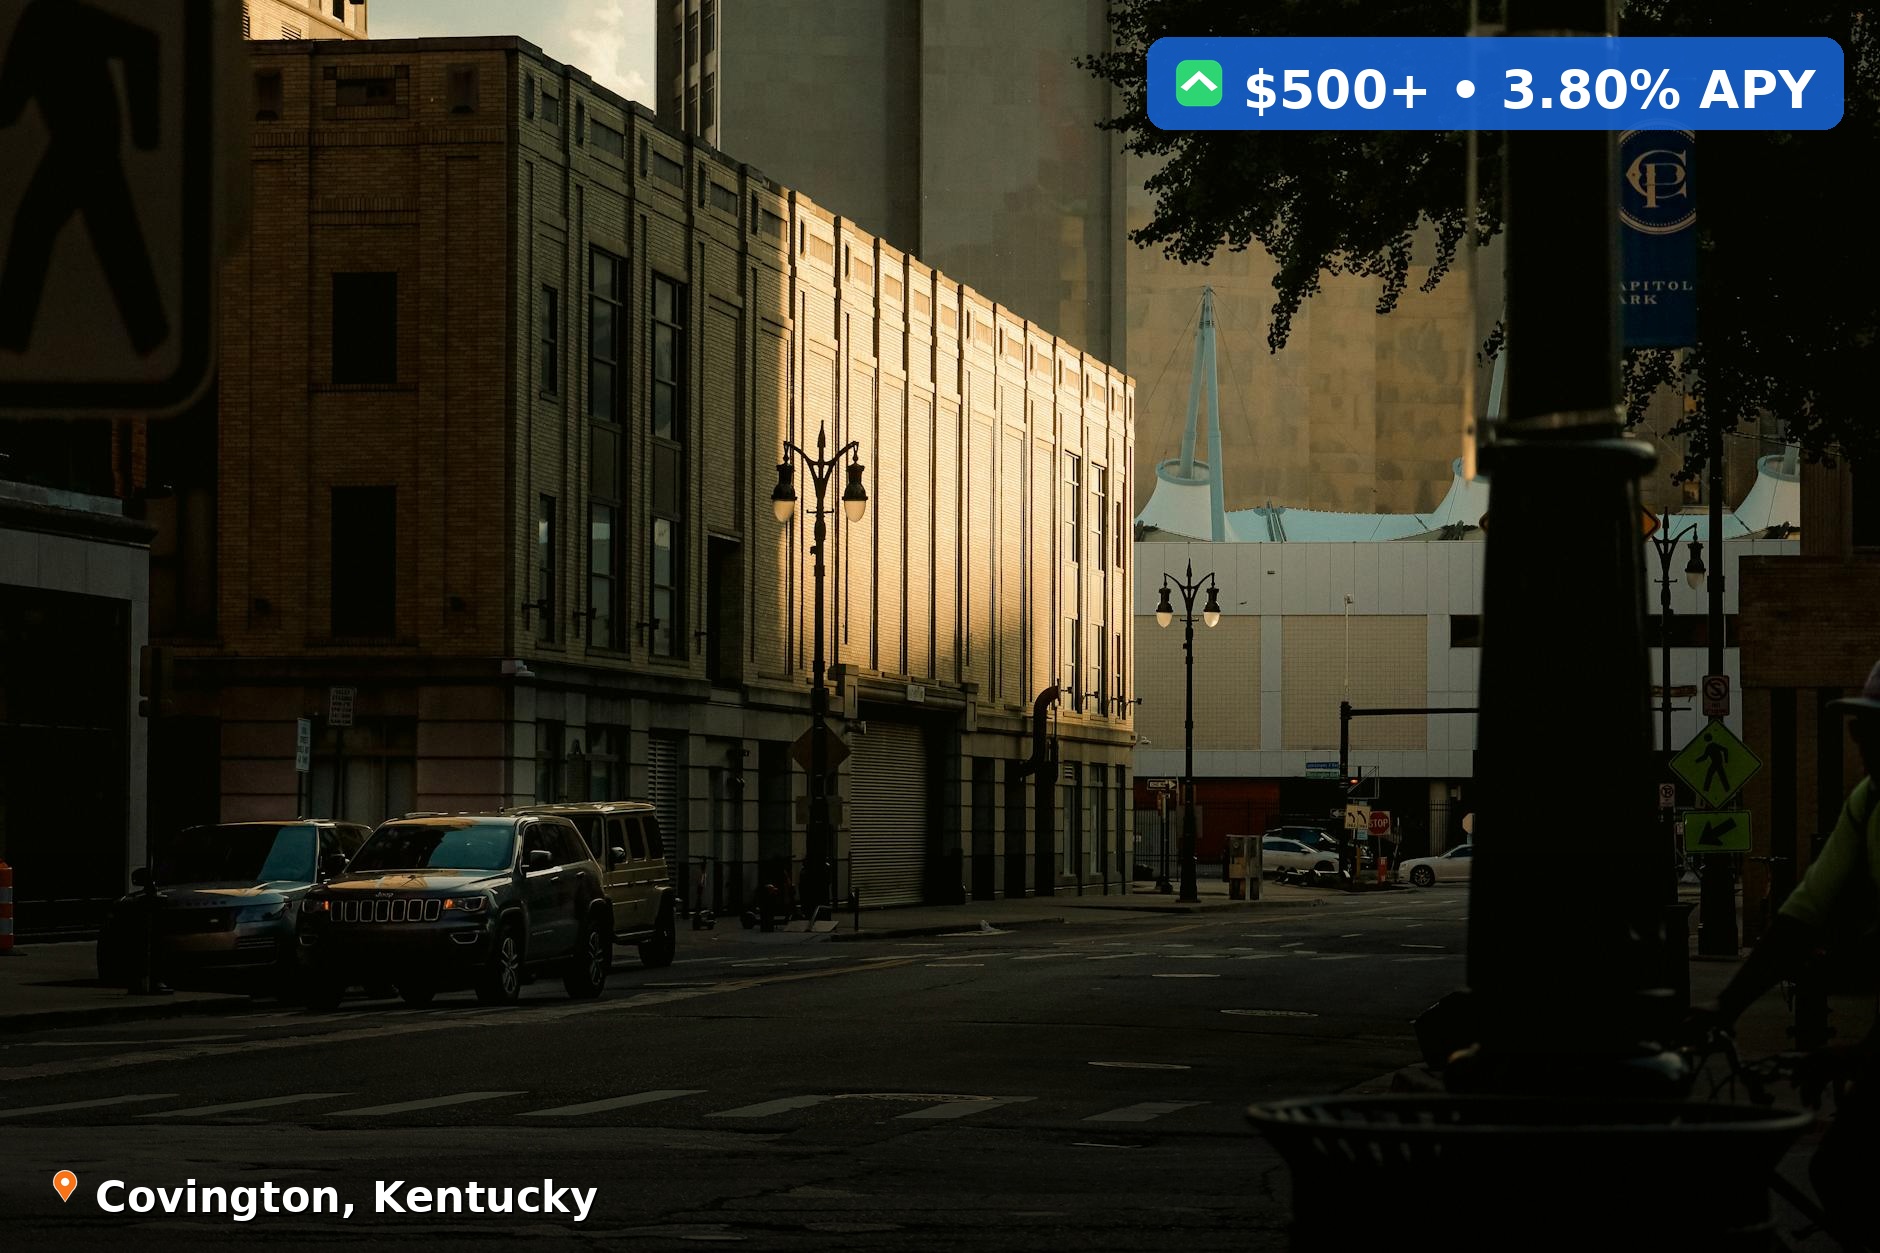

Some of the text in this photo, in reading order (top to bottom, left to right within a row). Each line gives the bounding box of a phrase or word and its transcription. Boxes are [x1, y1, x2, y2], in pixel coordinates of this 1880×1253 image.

[1619, 280, 1694, 291] APITOL
[1618, 293, 1659, 305] ARK
[1368, 818, 1389, 829] STOP
